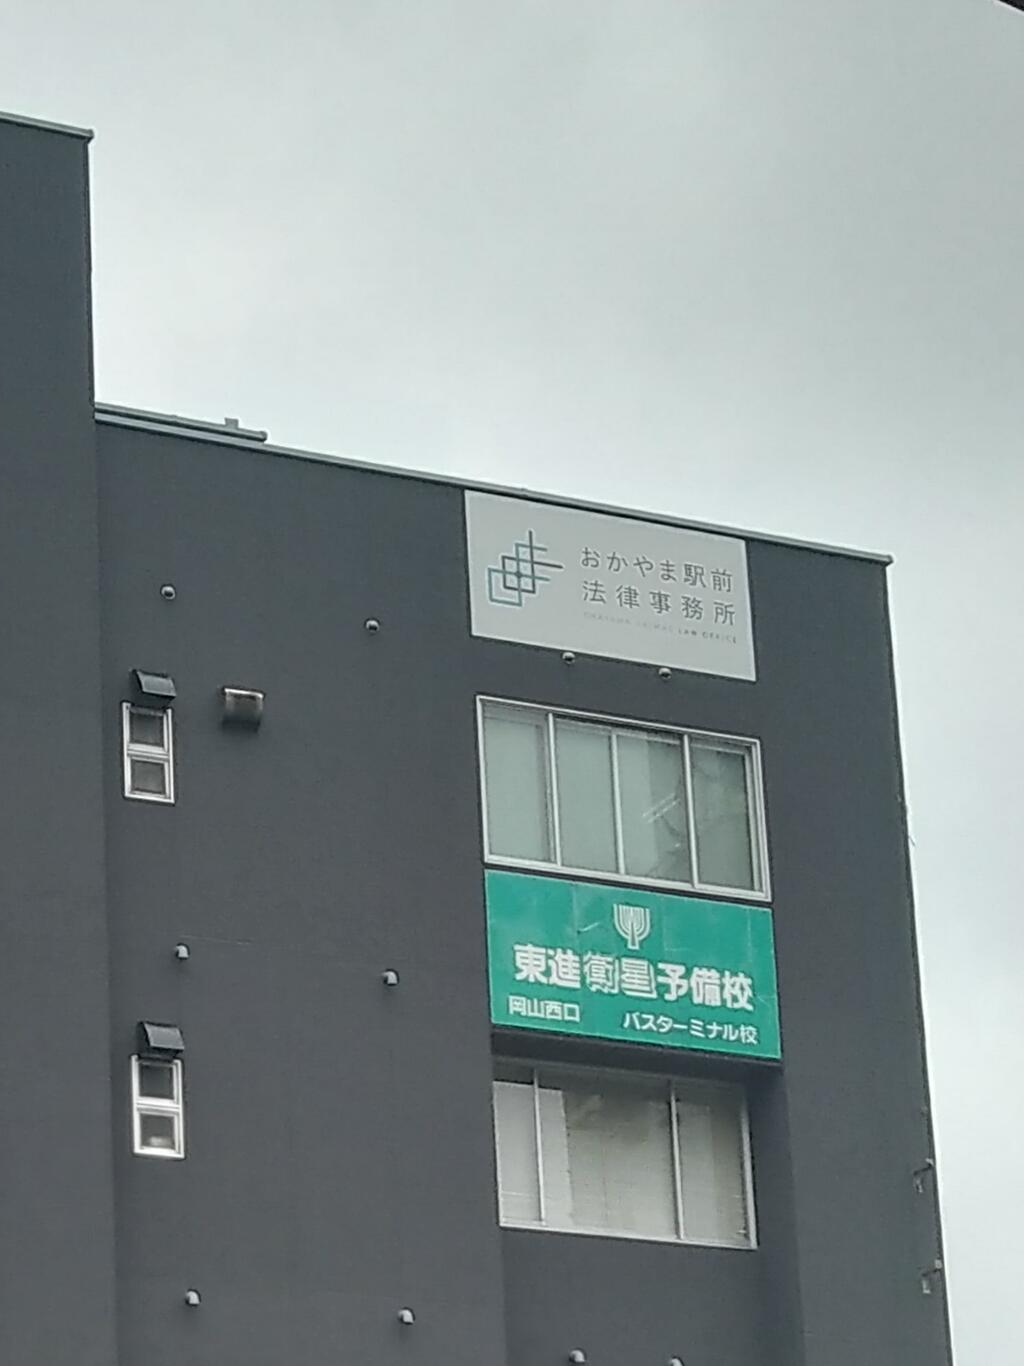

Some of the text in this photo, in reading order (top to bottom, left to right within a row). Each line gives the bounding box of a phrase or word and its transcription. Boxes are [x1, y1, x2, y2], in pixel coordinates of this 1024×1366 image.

[580, 547, 733, 593] おかやま駅前
[581, 579, 736, 626] 法律事務所
[513, 943, 755, 1011] 東進衛星予備校
[508, 994, 581, 1023] 岡山西口
[622, 1011, 759, 1045] バスターミナル校
